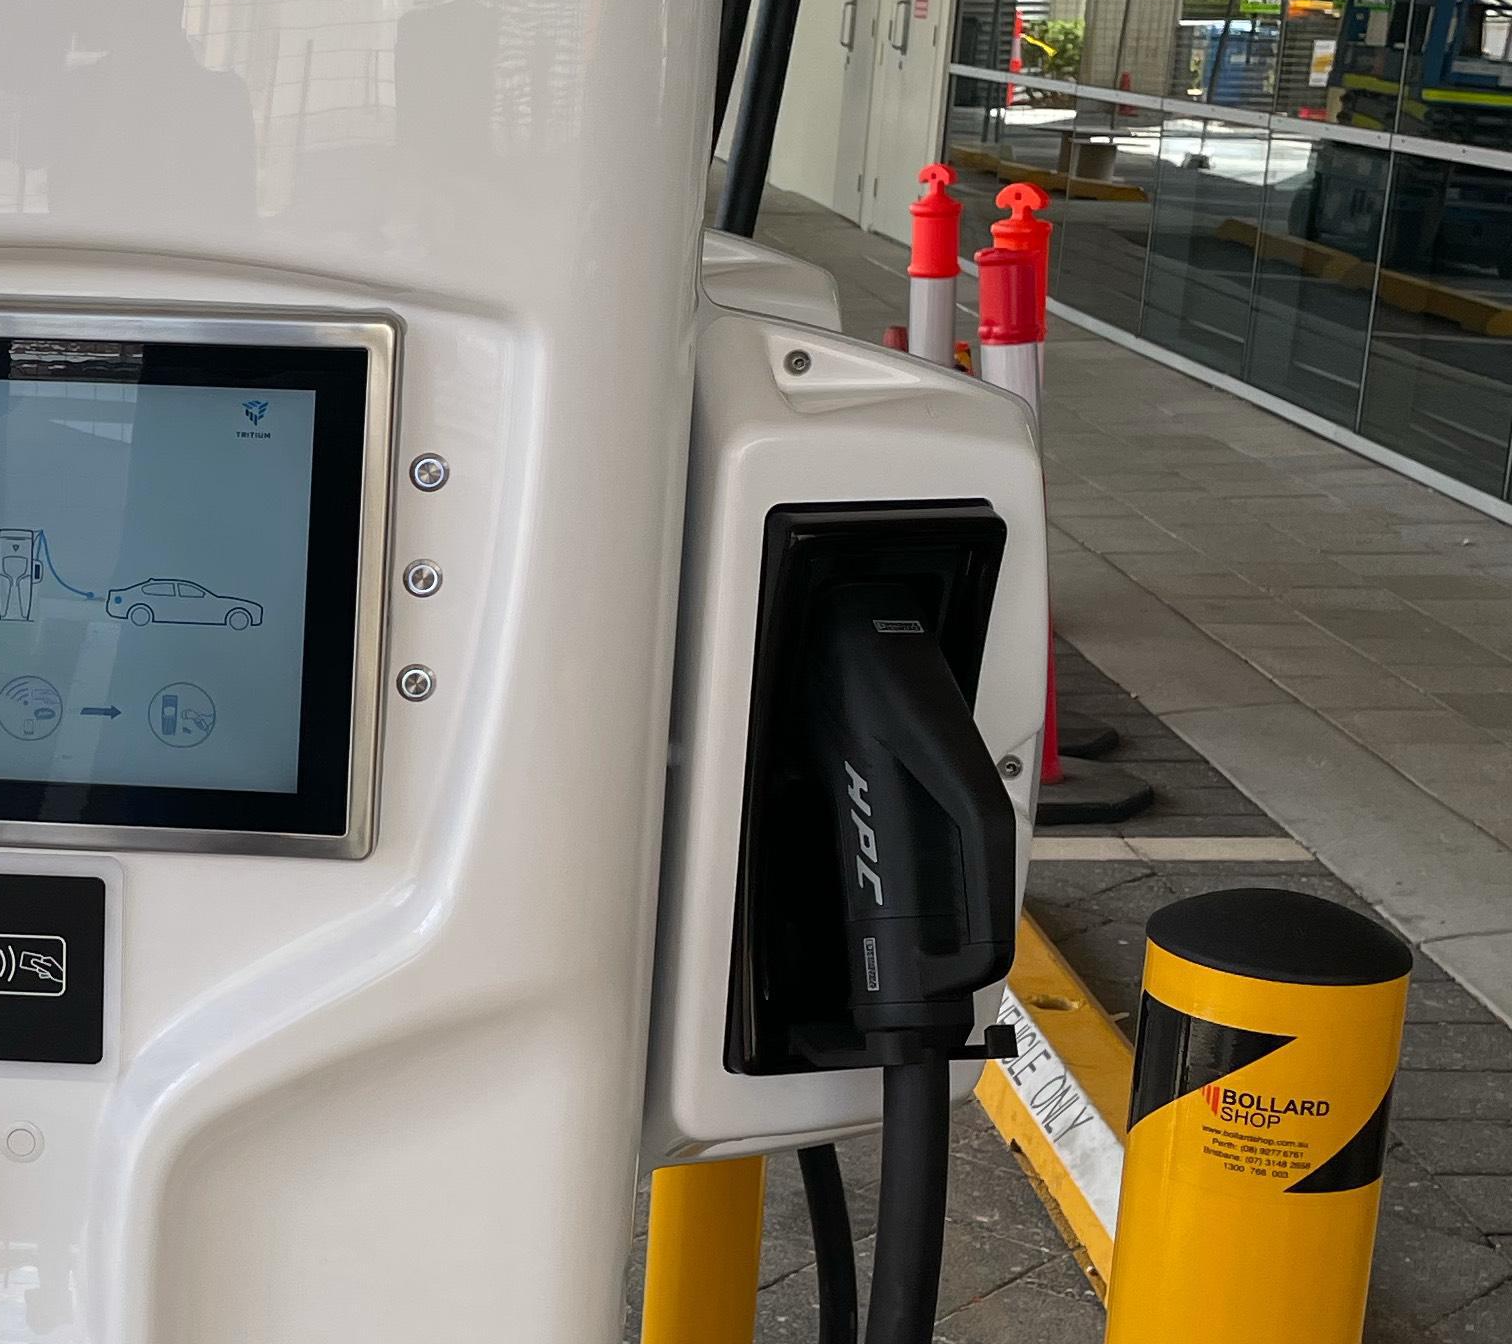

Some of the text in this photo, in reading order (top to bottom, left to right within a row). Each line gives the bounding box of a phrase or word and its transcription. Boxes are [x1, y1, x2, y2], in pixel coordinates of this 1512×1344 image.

[235, 431, 272, 439] TRITIUM
[843, 759, 884, 907] HPC
[1029, 1072, 1095, 1144] ONLY
[1222, 1088, 1330, 1117] BOLLARD
[1220, 1106, 1281, 1129] SHOP
